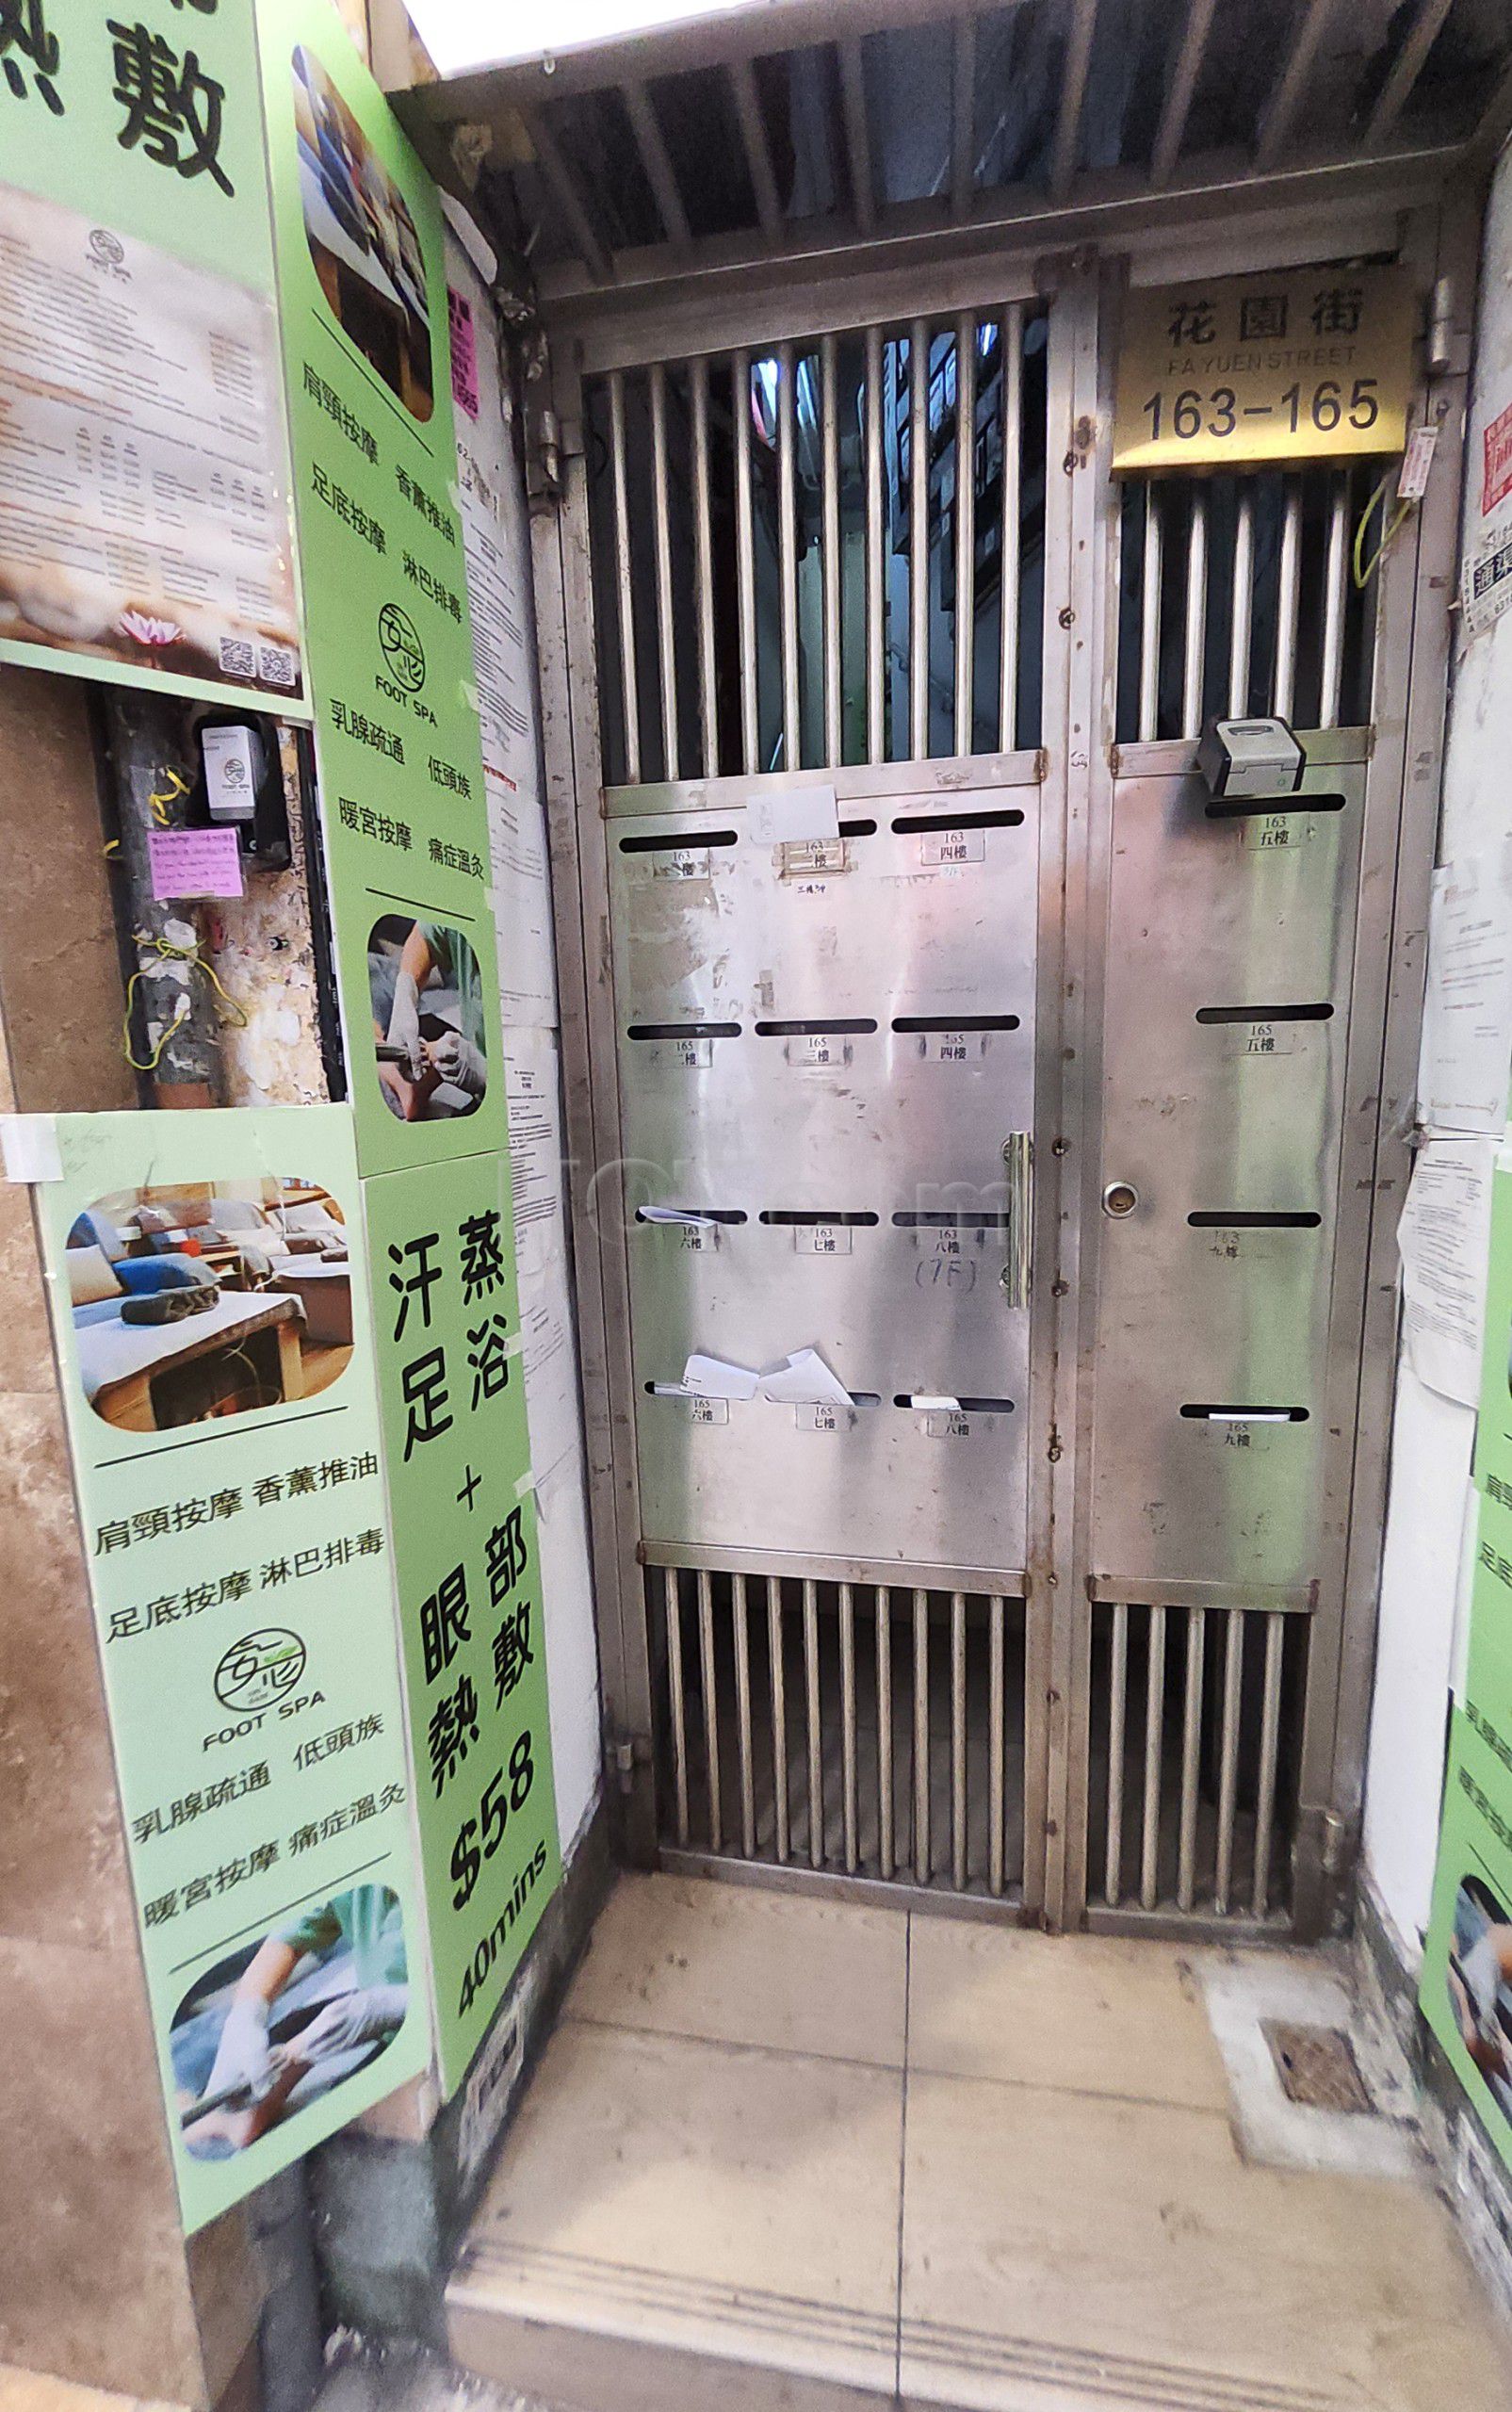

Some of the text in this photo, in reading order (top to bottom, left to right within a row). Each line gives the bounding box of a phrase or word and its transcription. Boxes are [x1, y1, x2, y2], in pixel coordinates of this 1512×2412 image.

[1168, 287, 1363, 348] 花園街
[1168, 346, 1357, 376] FA YUEN STREET
[303, 361, 379, 466] 肩頸按摩
[1143, 379, 1378, 440] 163-165
[312, 461, 387, 555] 足底按摩
[375, 676, 438, 728] FOOT SPA
[330, 698, 405, 765] 乳腺疏通
[428, 755, 472, 800] 低頭族
[338, 796, 413, 852] 暖宮按摩
[1264, 816, 1286, 829] 163
[945, 832, 964, 843] 163
[673, 851, 691, 861] 163
[940, 845, 967, 860] 四樓
[1251, 1024, 1272, 1036] 165
[676, 1041, 693, 1051] 165
[808, 1037, 827, 1048] 165
[940, 1046, 967, 1059] 四樓
[676, 1052, 696, 1066] 二樓
[806, 1049, 830, 1063] 三樓
[815, 1228, 833, 1238] 163
[940, 1230, 957, 1239] 163
[694, 1399, 710, 1408] 165
[816, 1406, 833, 1416] 165
[950, 1413, 967, 1422] 165
[94, 1451, 379, 1556] 肩頸按摩 香薰推油
[106, 1528, 384, 1644] 足底按摩 淋巴排毒
[202, 1713, 267, 1752] FOOT
[278, 1690, 326, 1720] SPA
[131, 1714, 384, 1843] 乳腺疏通 低頭族
[451, 1730, 533, 1912] $58
[144, 1839, 281, 1929] 暖宮按摩
[459, 1839, 547, 2020] 40mins
